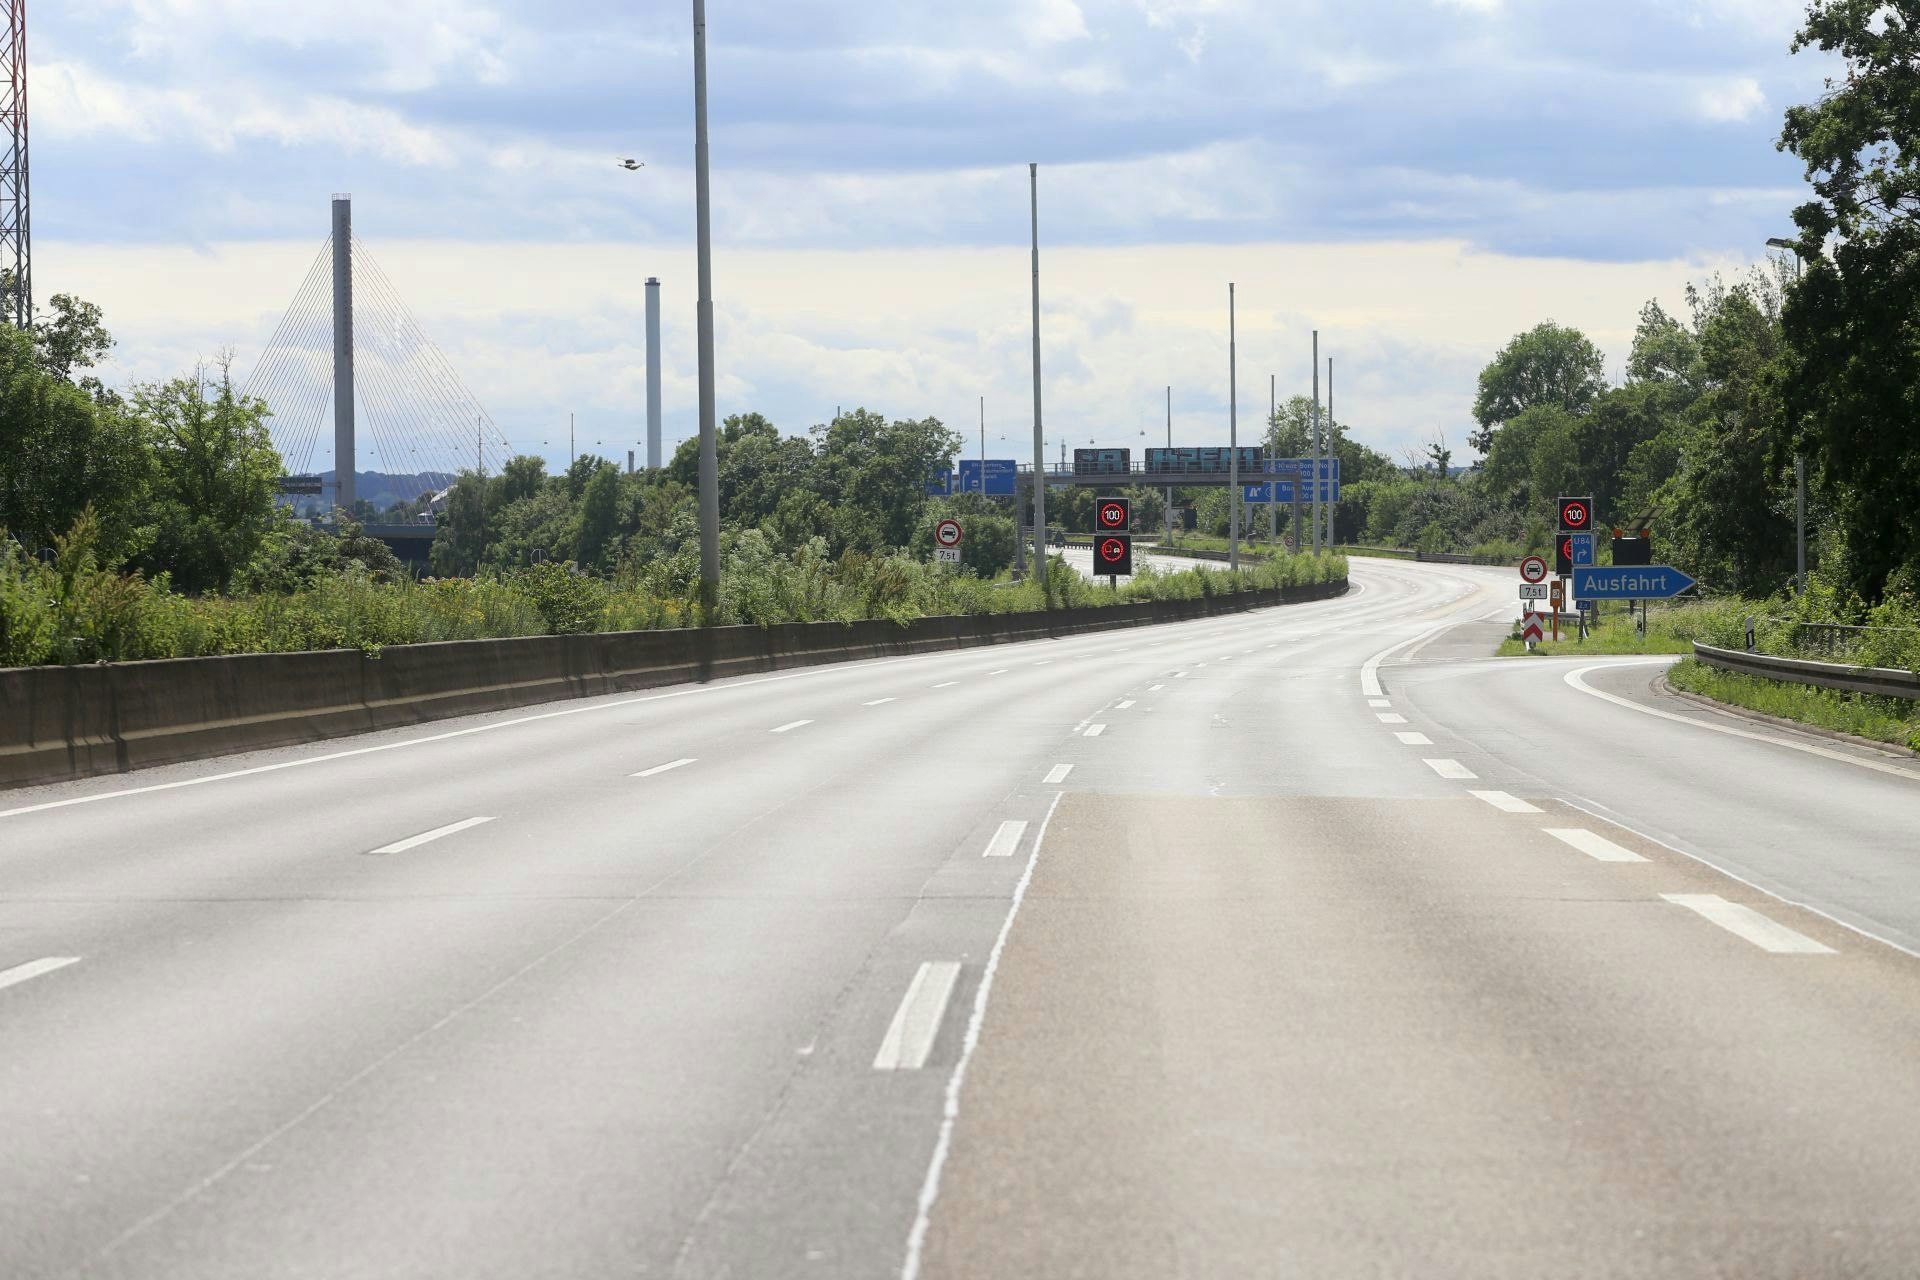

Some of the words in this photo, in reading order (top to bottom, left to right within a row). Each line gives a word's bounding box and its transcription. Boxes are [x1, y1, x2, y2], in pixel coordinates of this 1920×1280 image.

[1105, 510, 1120, 520] 100
[1567, 509, 1583, 520] 100
[1584, 574, 1666, 591] Ausfahrt
